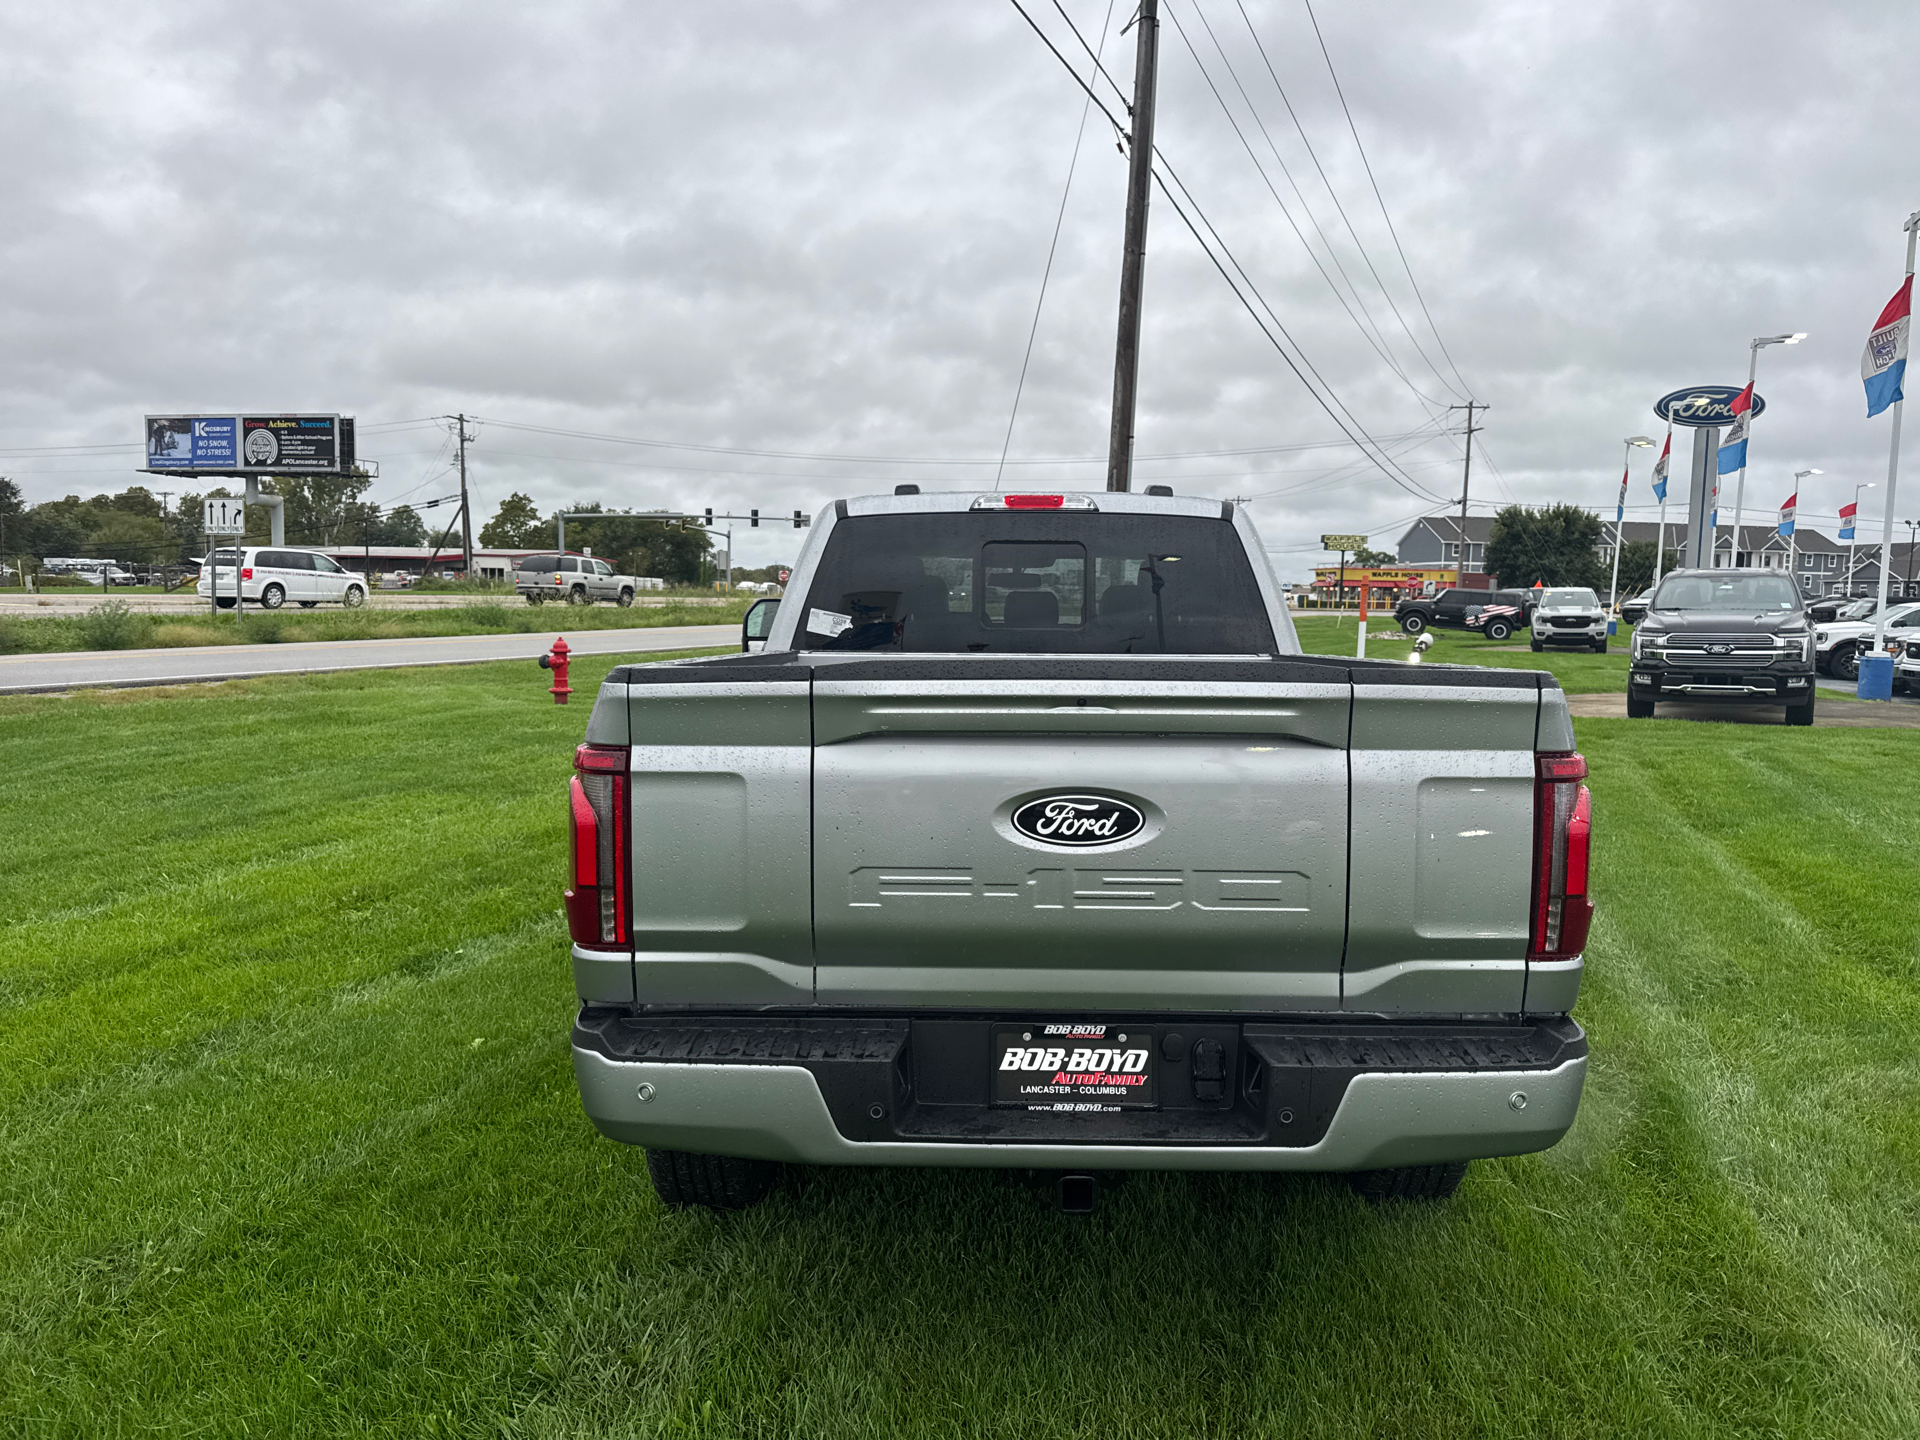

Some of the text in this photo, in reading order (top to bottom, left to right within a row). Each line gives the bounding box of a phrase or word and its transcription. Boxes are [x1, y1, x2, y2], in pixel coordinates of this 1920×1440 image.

[268, 420, 298, 428] Achieve.
[300, 420, 332, 428] Succeed.
[209, 440, 229, 448] SNOW,
[1036, 801, 1119, 837] Ford
[849, 866, 1311, 911] F-150
[1020, 1085, 1071, 1094] LANCASTER
[1079, 1086, 1127, 1095] COLUMBUS
